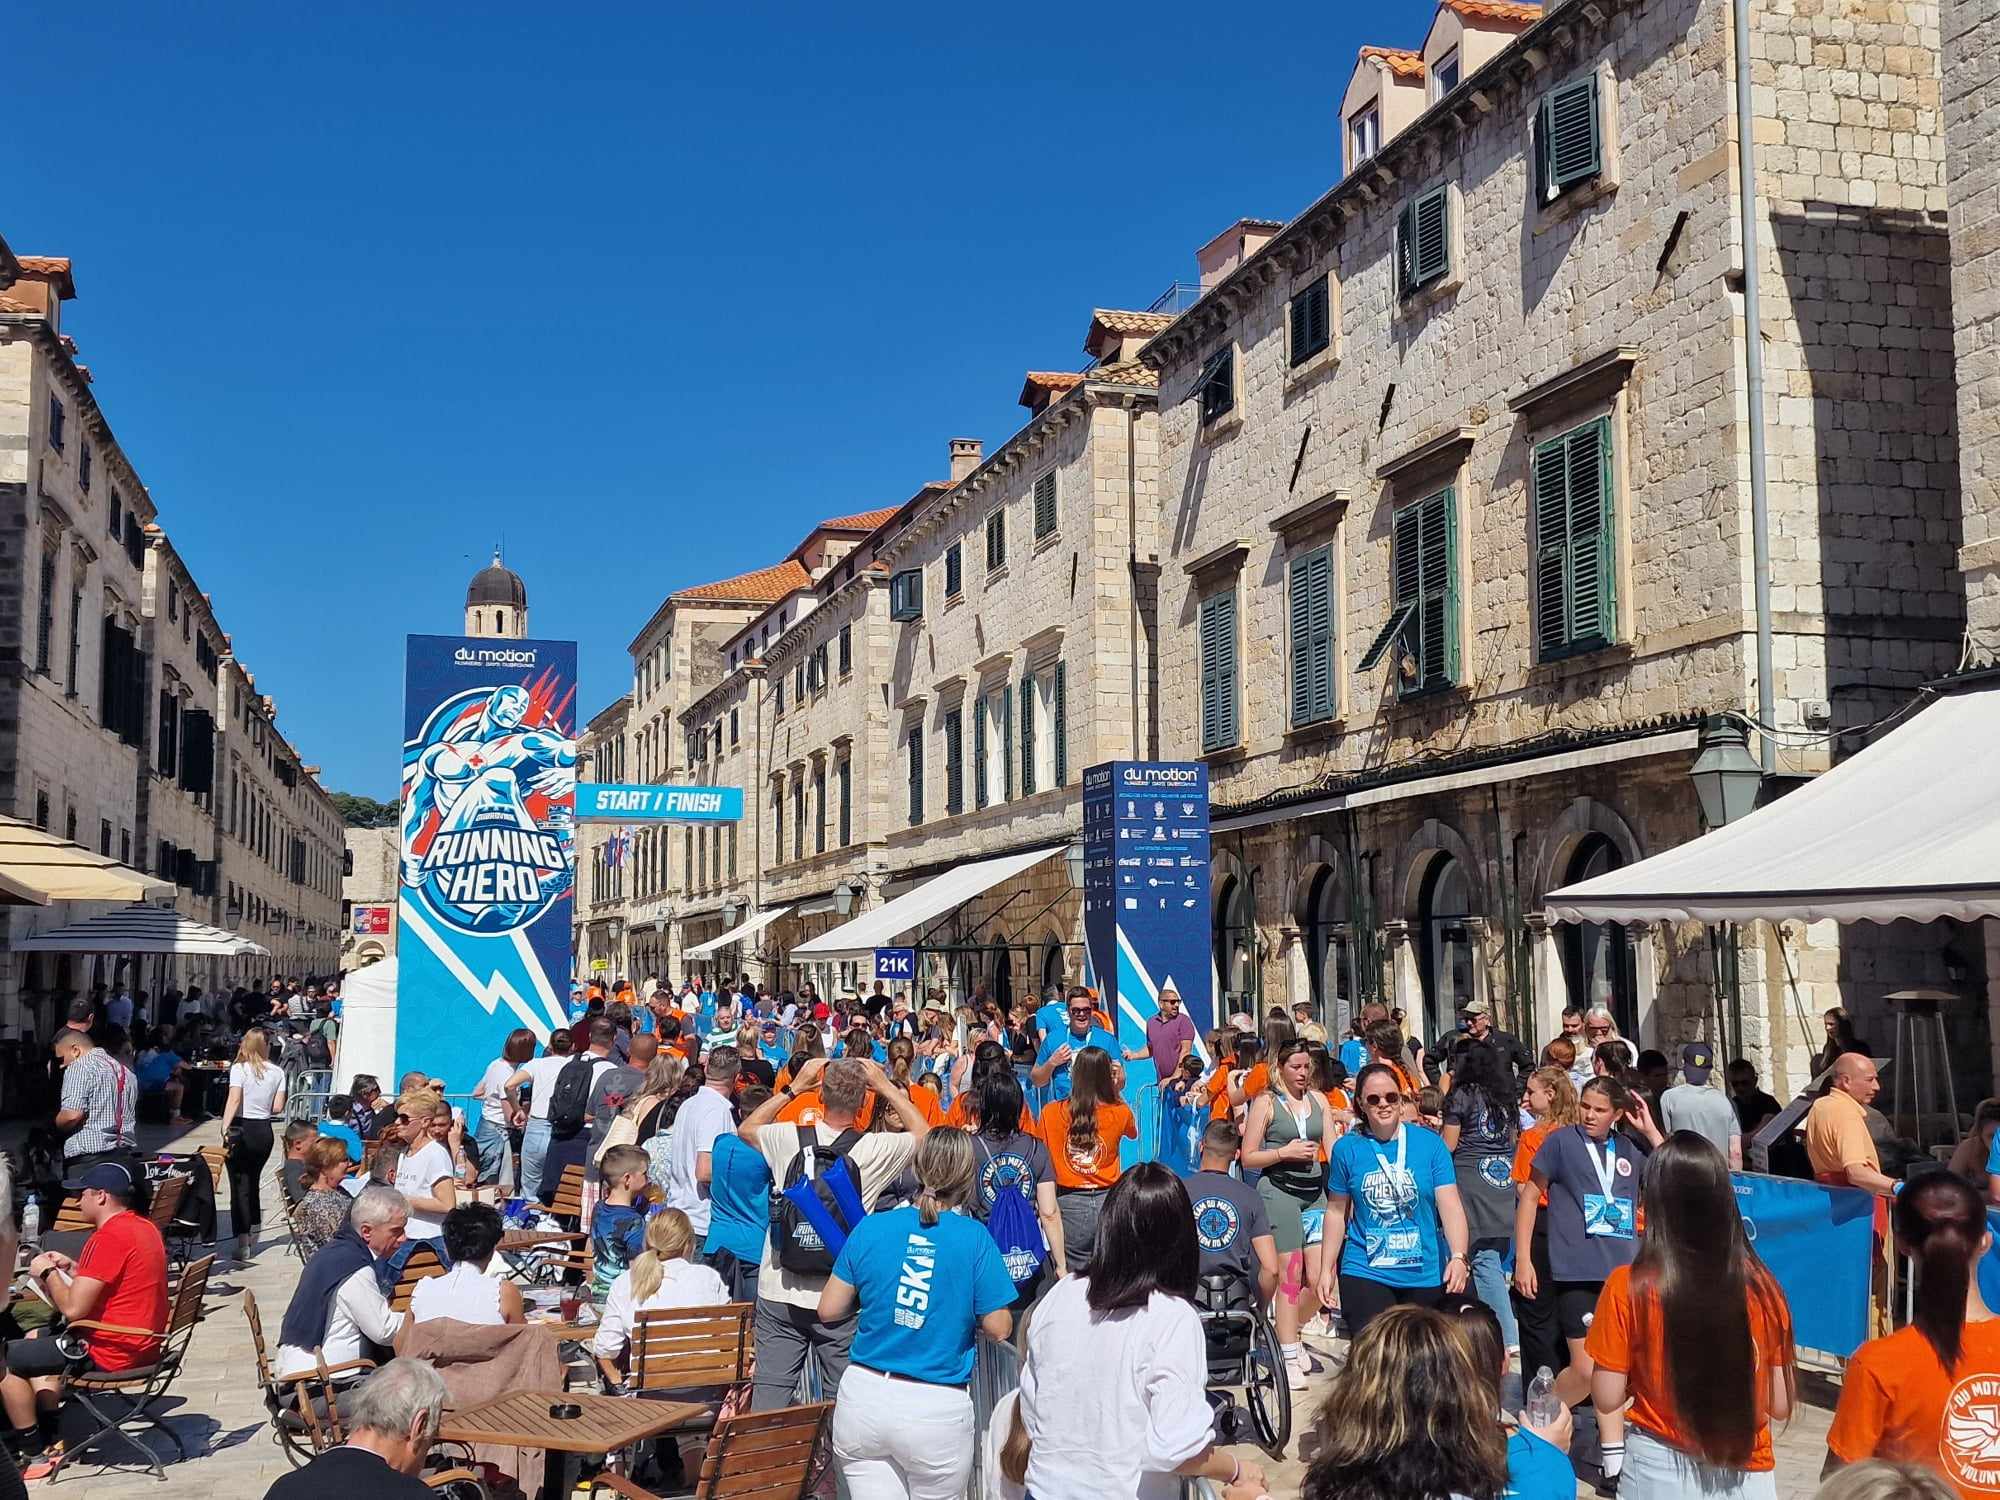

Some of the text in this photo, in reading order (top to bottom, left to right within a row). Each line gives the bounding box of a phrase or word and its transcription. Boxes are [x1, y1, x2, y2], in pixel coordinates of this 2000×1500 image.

[454, 647, 535, 663] du motion
[1124, 767, 1198, 782] du motion
[596, 790, 723, 813] START / FINISH
[423, 828, 565, 870] RUNNING
[449, 862, 540, 902] HERO
[880, 957, 909, 973] 21K
[1953, 1380, 2000, 1408] DU MOT
